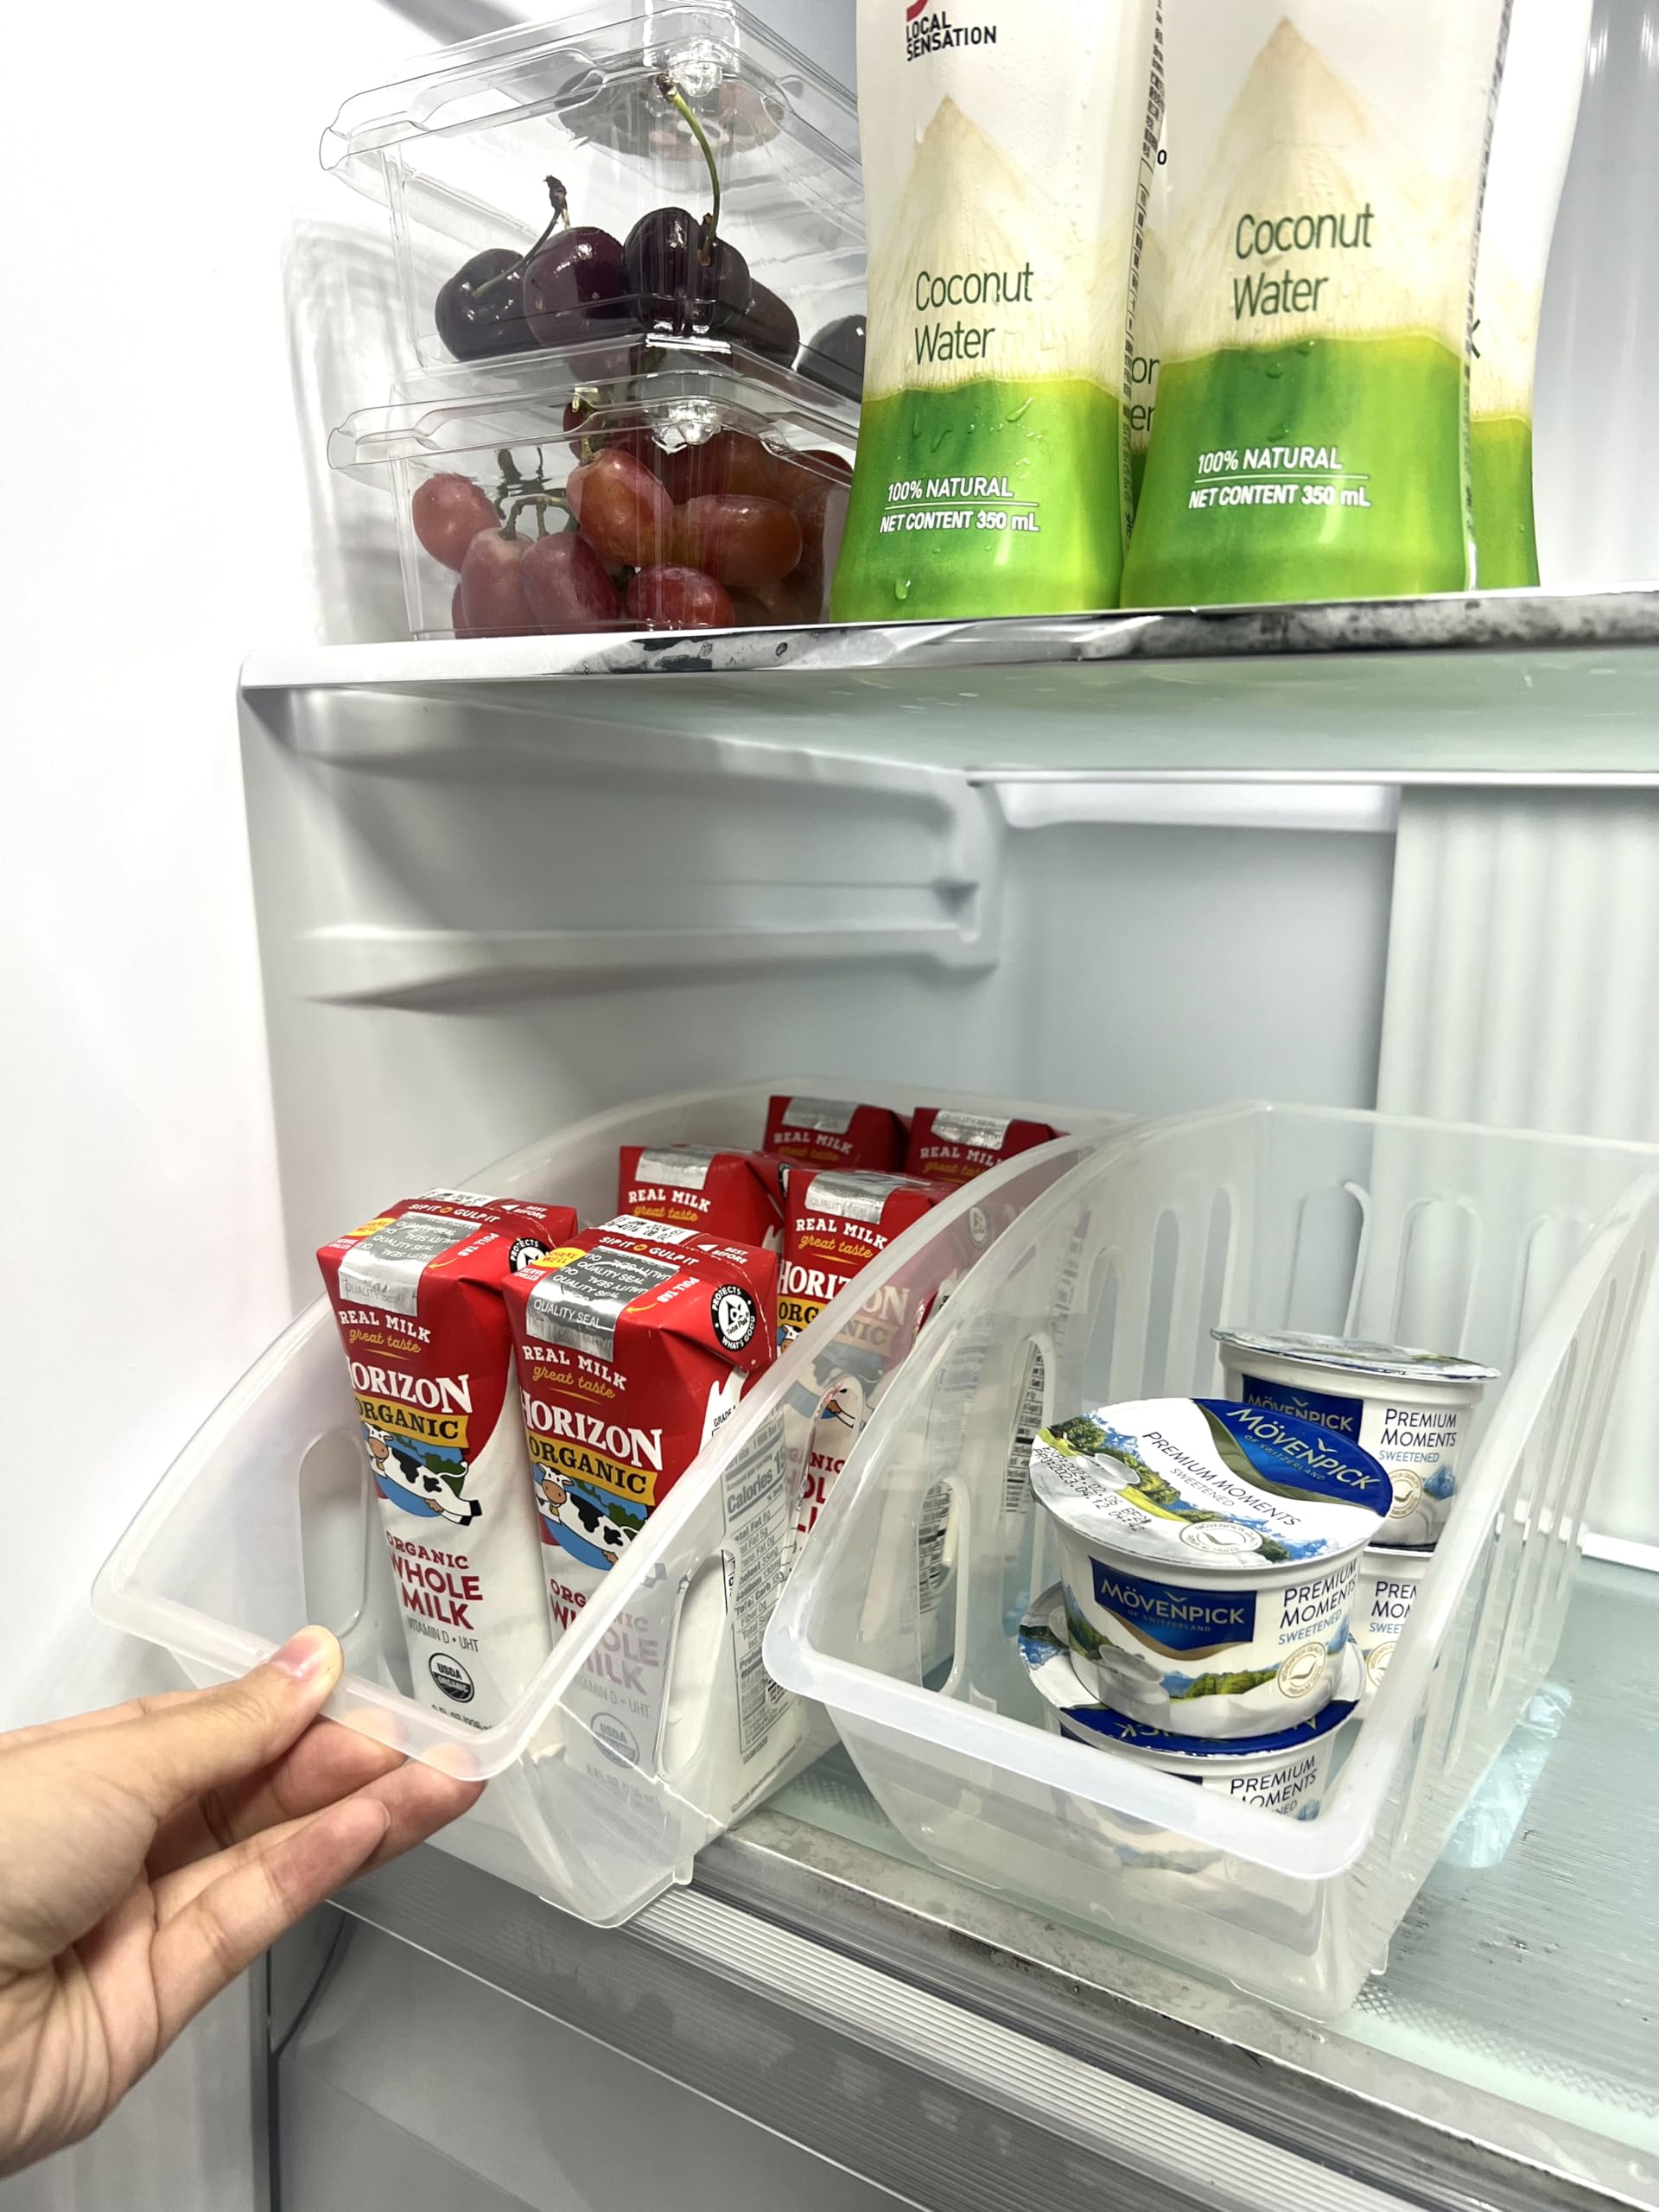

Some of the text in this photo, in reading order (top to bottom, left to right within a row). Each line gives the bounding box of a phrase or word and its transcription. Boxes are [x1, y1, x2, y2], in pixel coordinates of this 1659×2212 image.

[906, 11, 951, 42] LOCAL
[906, 26, 997, 61] SENSATION
[1236, 204, 1375, 259] Coconut
[916, 263, 1033, 311] Coconut
[1232, 270, 1329, 320] Water
[914, 321, 995, 365] Water
[1198, 447, 1343, 474] 100% NATURAL
[887, 476, 1014, 502] 100% NATURAL
[1189, 484, 1372, 509] NET CONTENT 350 mL
[880, 510, 1040, 533] NET CONTENT 350 mL
[774, 1132, 853, 1154] REAL MILK
[920, 1147, 960, 1159] REAL
[628, 1189, 711, 1212] REAL MILK
[796, 1217, 887, 1249] REAL MILK
[798, 1236, 873, 1258] great taste
[511, 1239, 539, 1262] PROTECTS
[599, 1236, 622, 1247] SIP
[649, 1248, 687, 1263] GULP
[682, 1255, 700, 1265] IT
[553, 1274, 594, 1294] QUALITY
[619, 1274, 644, 1285] SEAL
[657, 1276, 700, 1303] PULL TAB
[533, 1299, 601, 1328] QUALITY SEAL
[712, 1286, 741, 1311] PROTECTS
[339, 1311, 431, 1344] REAL MILK
[349, 1329, 421, 1353] great taste
[722, 1316, 755, 1350] WHAT'S GOOD
[522, 1345, 627, 1391] REAL MILK
[533, 1367, 615, 1399] great taste
[355, 1397, 458, 1440] ORGANIC
[520, 1385, 663, 1471] HORIZON
[1384, 1408, 1456, 1428] PREMIUM
[1225, 1408, 1381, 1491] MÖVENPICK
[1380, 1428, 1457, 1447] MOMENTS
[529, 1436, 646, 1494] ORGANIC
[1258, 1442, 1326, 1481] SWITZERLAND
[1378, 1450, 1439, 1463] SWEETENED
[728, 1470, 772, 1514] Calories
[1142, 1431, 1302, 1527] PREMIUM MOMENTS
[1170, 1467, 1235, 1507] SWEETENED
[387, 1531, 470, 1570] ORGANIC
[390, 1551, 483, 1601] WHOLE
[1284, 1558, 1357, 1607] PREMIUM
[402, 1582, 474, 1630] MILK
[1101, 1579, 1245, 1624] MÖVENPICK
[442, 1630, 449, 1643] D
[459, 1636, 479, 1652] UHT
[1278, 1609, 1341, 1645] SWEETENED
[436, 1662, 462, 1680] USDA
[1230, 1755, 1315, 1795] PREMIUM
[1242, 1769, 1317, 1808] OMENTS
